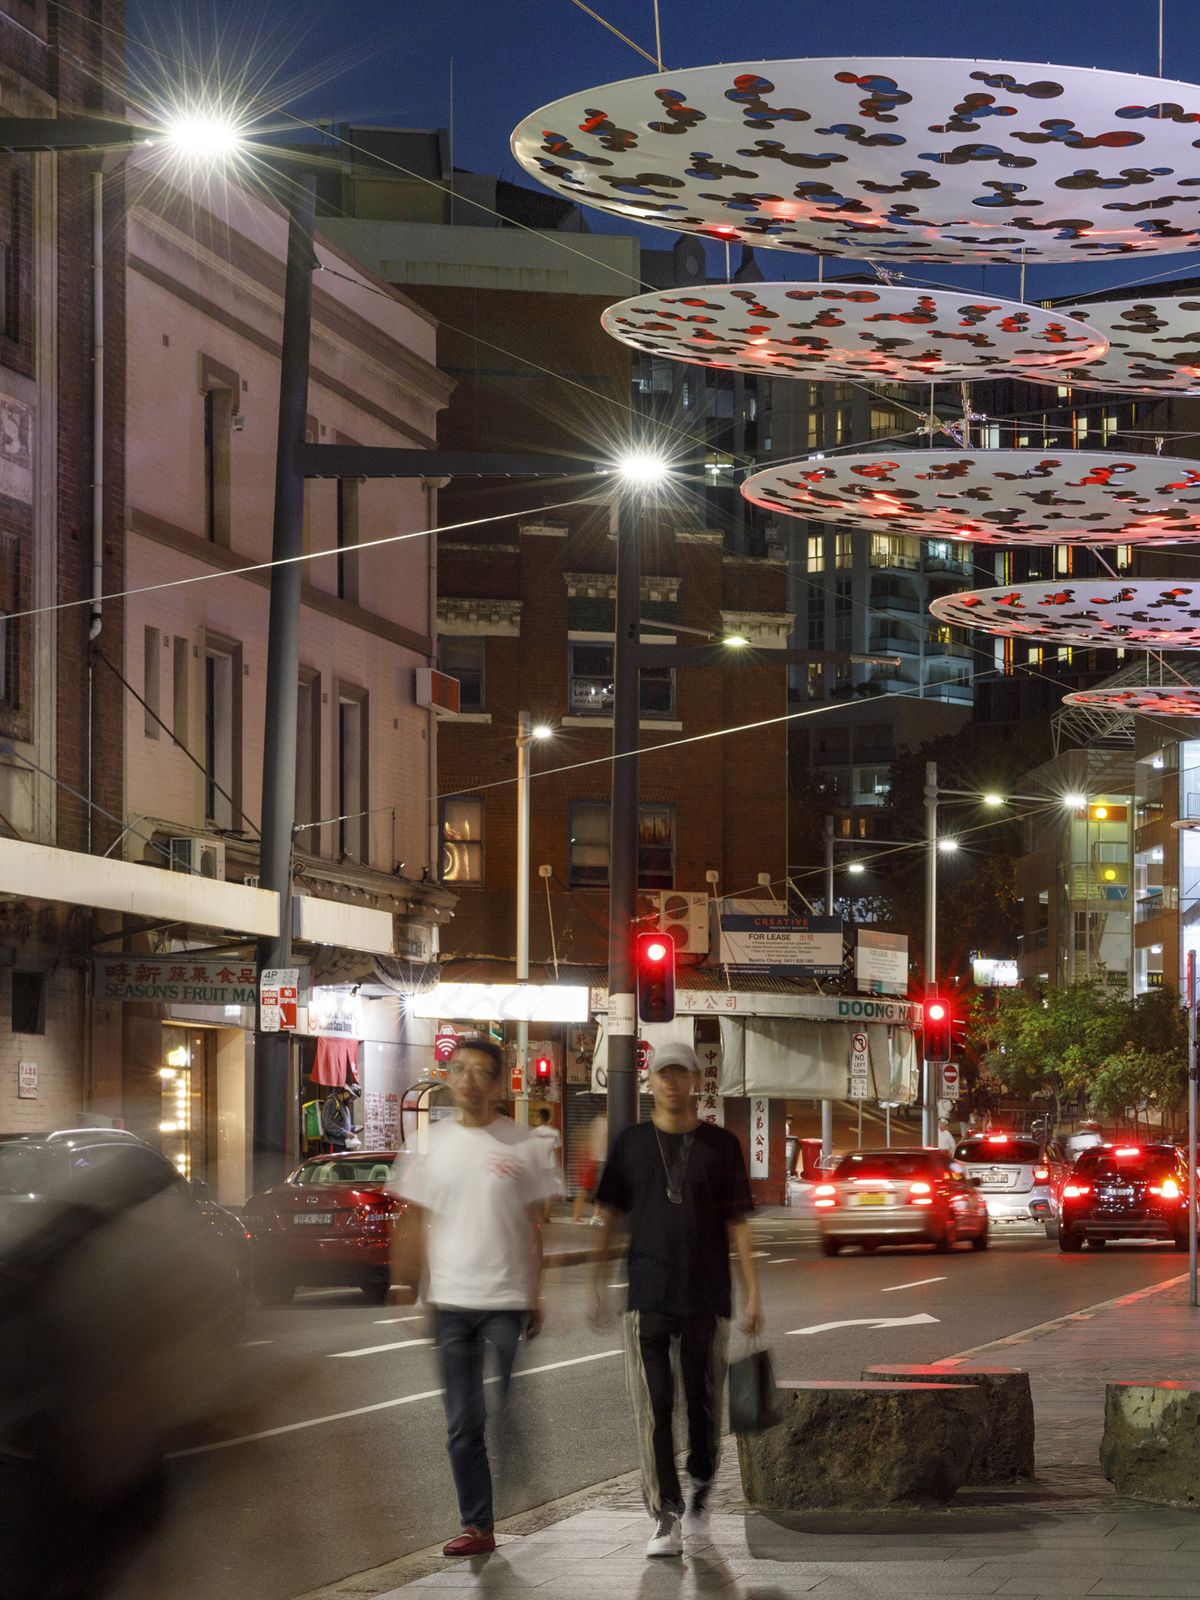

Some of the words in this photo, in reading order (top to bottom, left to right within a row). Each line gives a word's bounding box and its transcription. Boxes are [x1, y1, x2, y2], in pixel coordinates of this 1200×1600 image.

[753, 918, 809, 926] CREATIVE
[748, 933, 765, 941] FOR
[766, 933, 791, 941] LEASE
[263, 970, 278, 979] 4P
[104, 982, 179, 1000] SEASON'S
[183, 985, 229, 1001] FRUIT
[838, 1000, 894, 1018] DOONG
[754, 1100, 766, 1164] 兄弟公司
